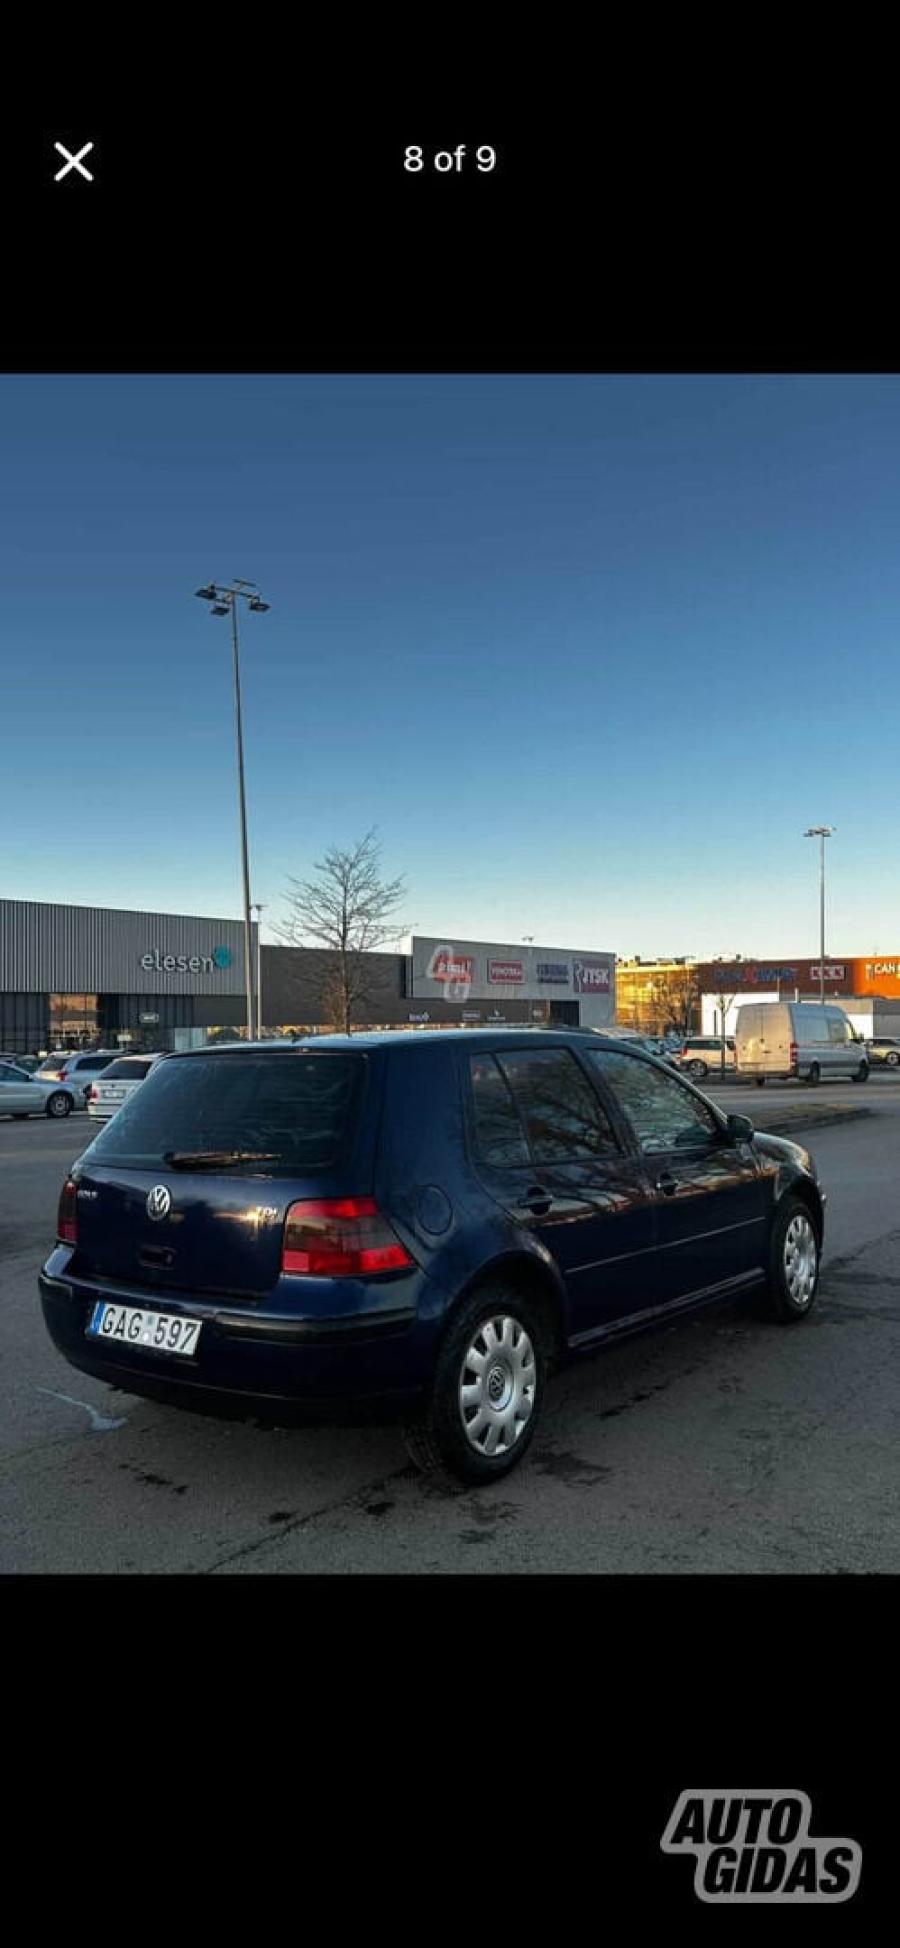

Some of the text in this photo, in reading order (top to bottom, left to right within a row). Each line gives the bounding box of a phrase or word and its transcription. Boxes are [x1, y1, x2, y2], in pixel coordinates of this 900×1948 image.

[141, 950, 214, 973] elesen
[582, 967, 610, 984] JYSK
[102, 1307, 198, 1350] GAG 597
